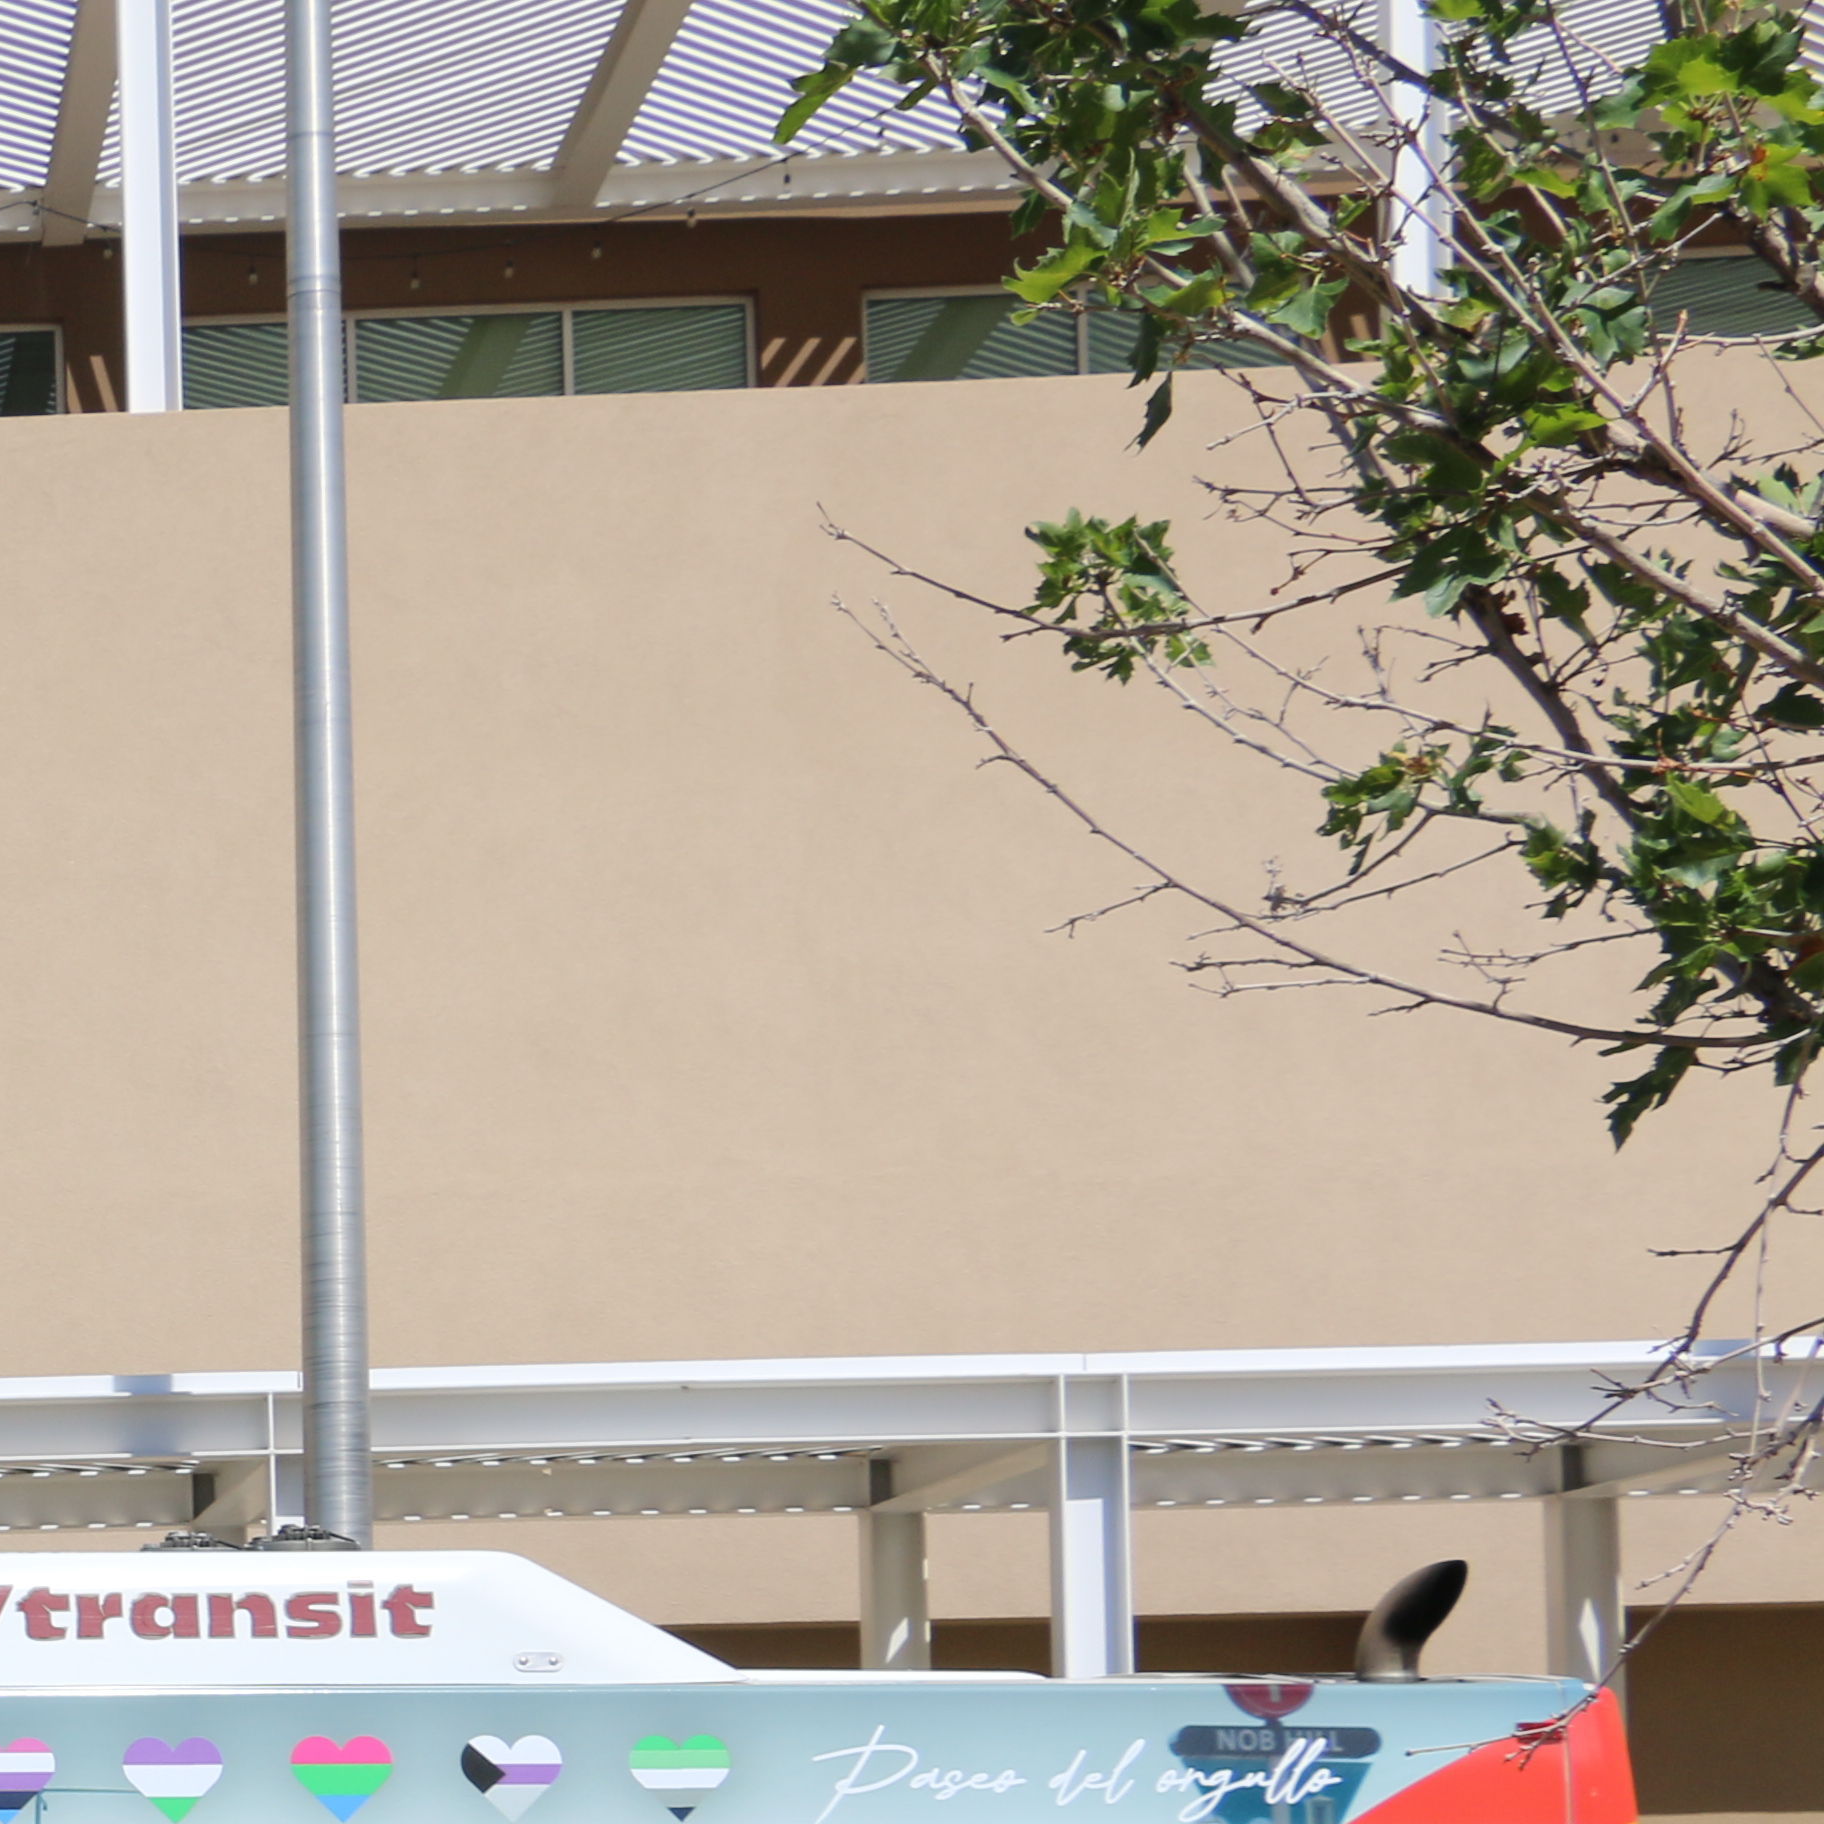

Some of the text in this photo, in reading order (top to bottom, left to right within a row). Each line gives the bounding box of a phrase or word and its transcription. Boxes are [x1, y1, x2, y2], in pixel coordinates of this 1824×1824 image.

[1216, 1728, 1276, 1751] NOB
[1047, 1738, 1148, 1806] del
[1155, 1737, 1344, 1823] orgullo
